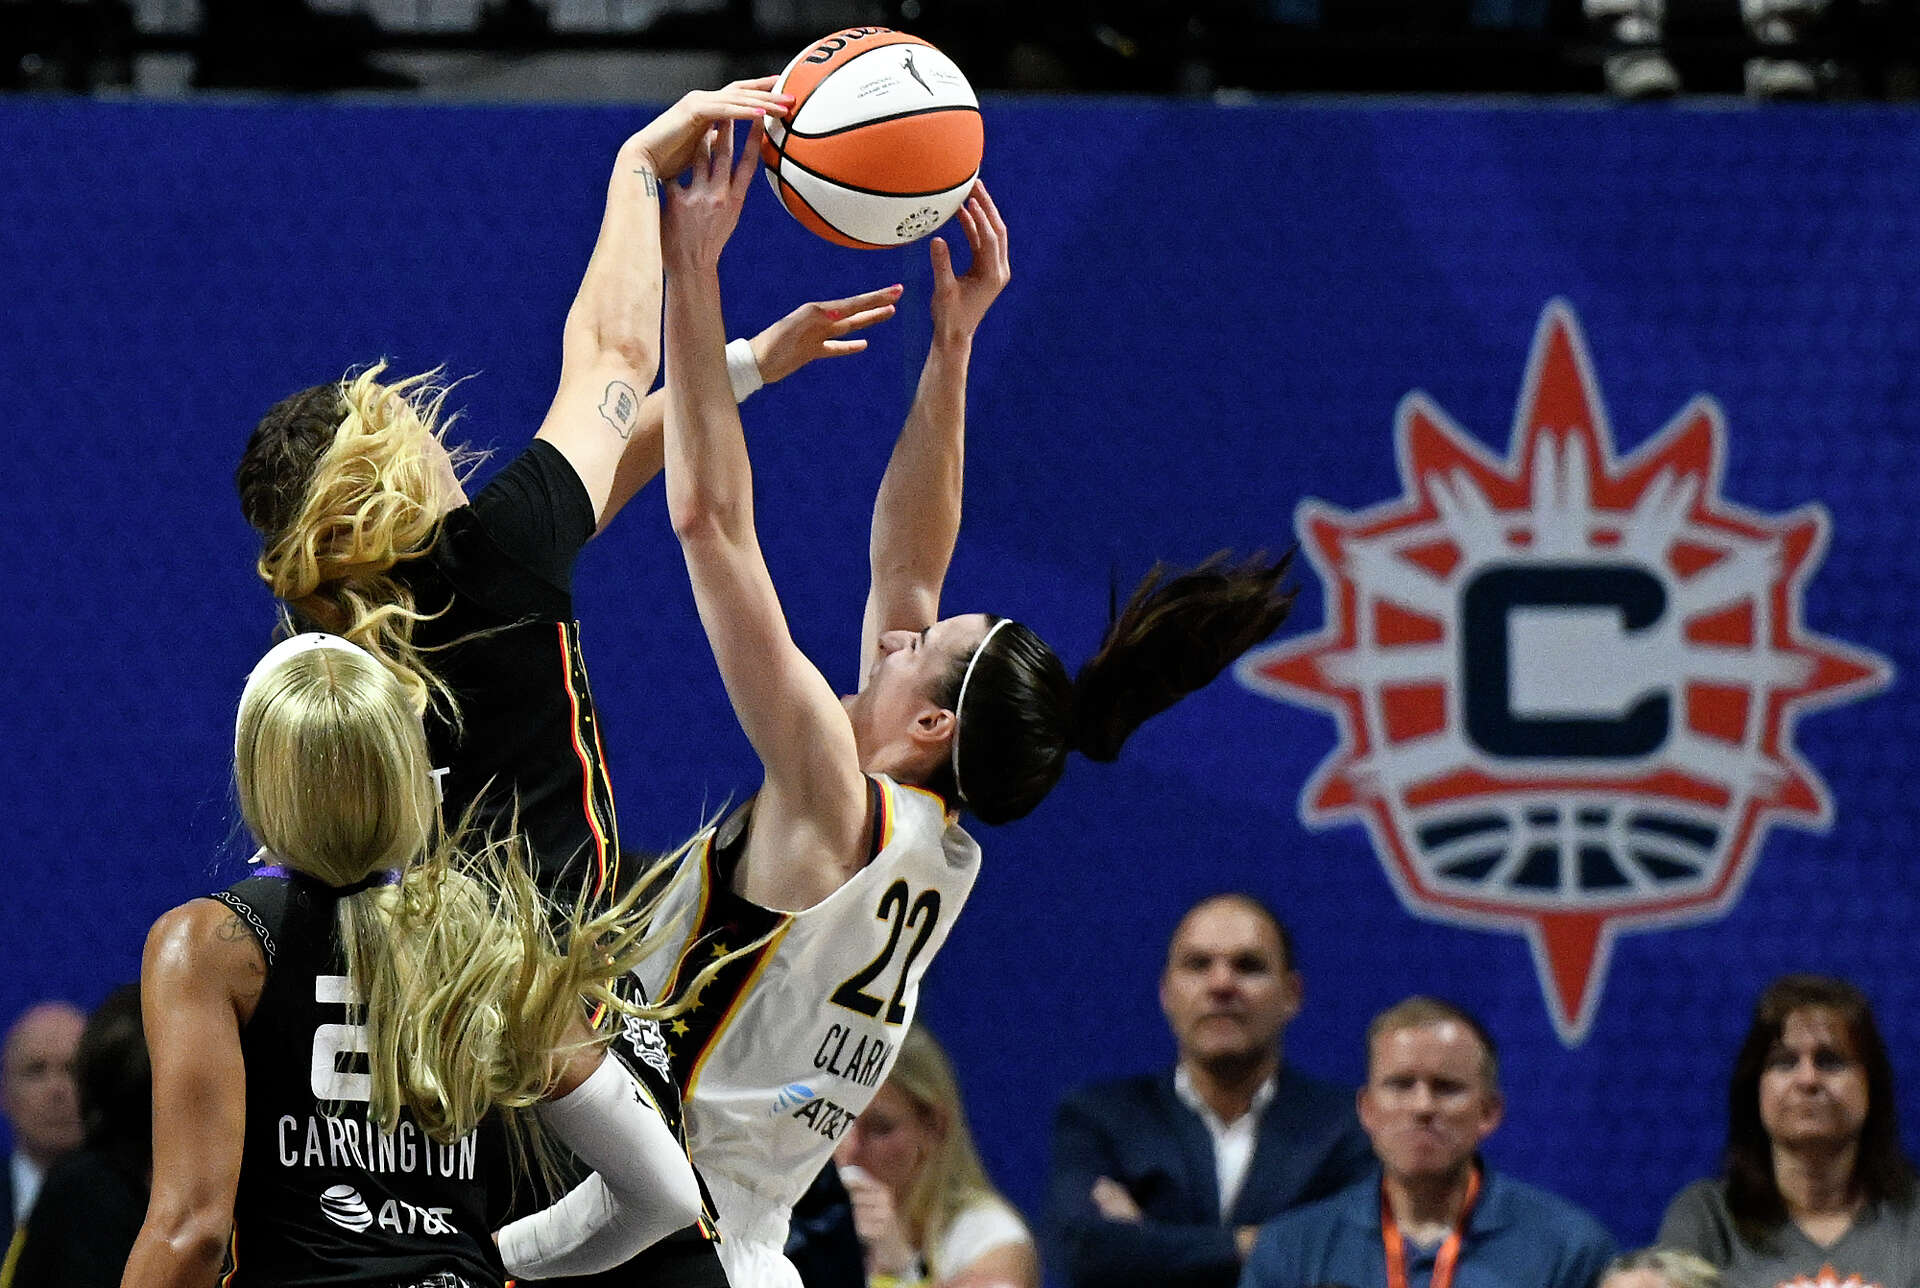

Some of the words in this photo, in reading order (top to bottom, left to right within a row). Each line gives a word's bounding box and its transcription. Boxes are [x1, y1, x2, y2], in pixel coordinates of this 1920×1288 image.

[1462, 564, 1669, 758] C
[829, 877, 941, 1026] 22
[813, 1023, 894, 1088] CLARK
[792, 1097, 856, 1140] AT&T
[378, 1199, 458, 1235] AT&T
